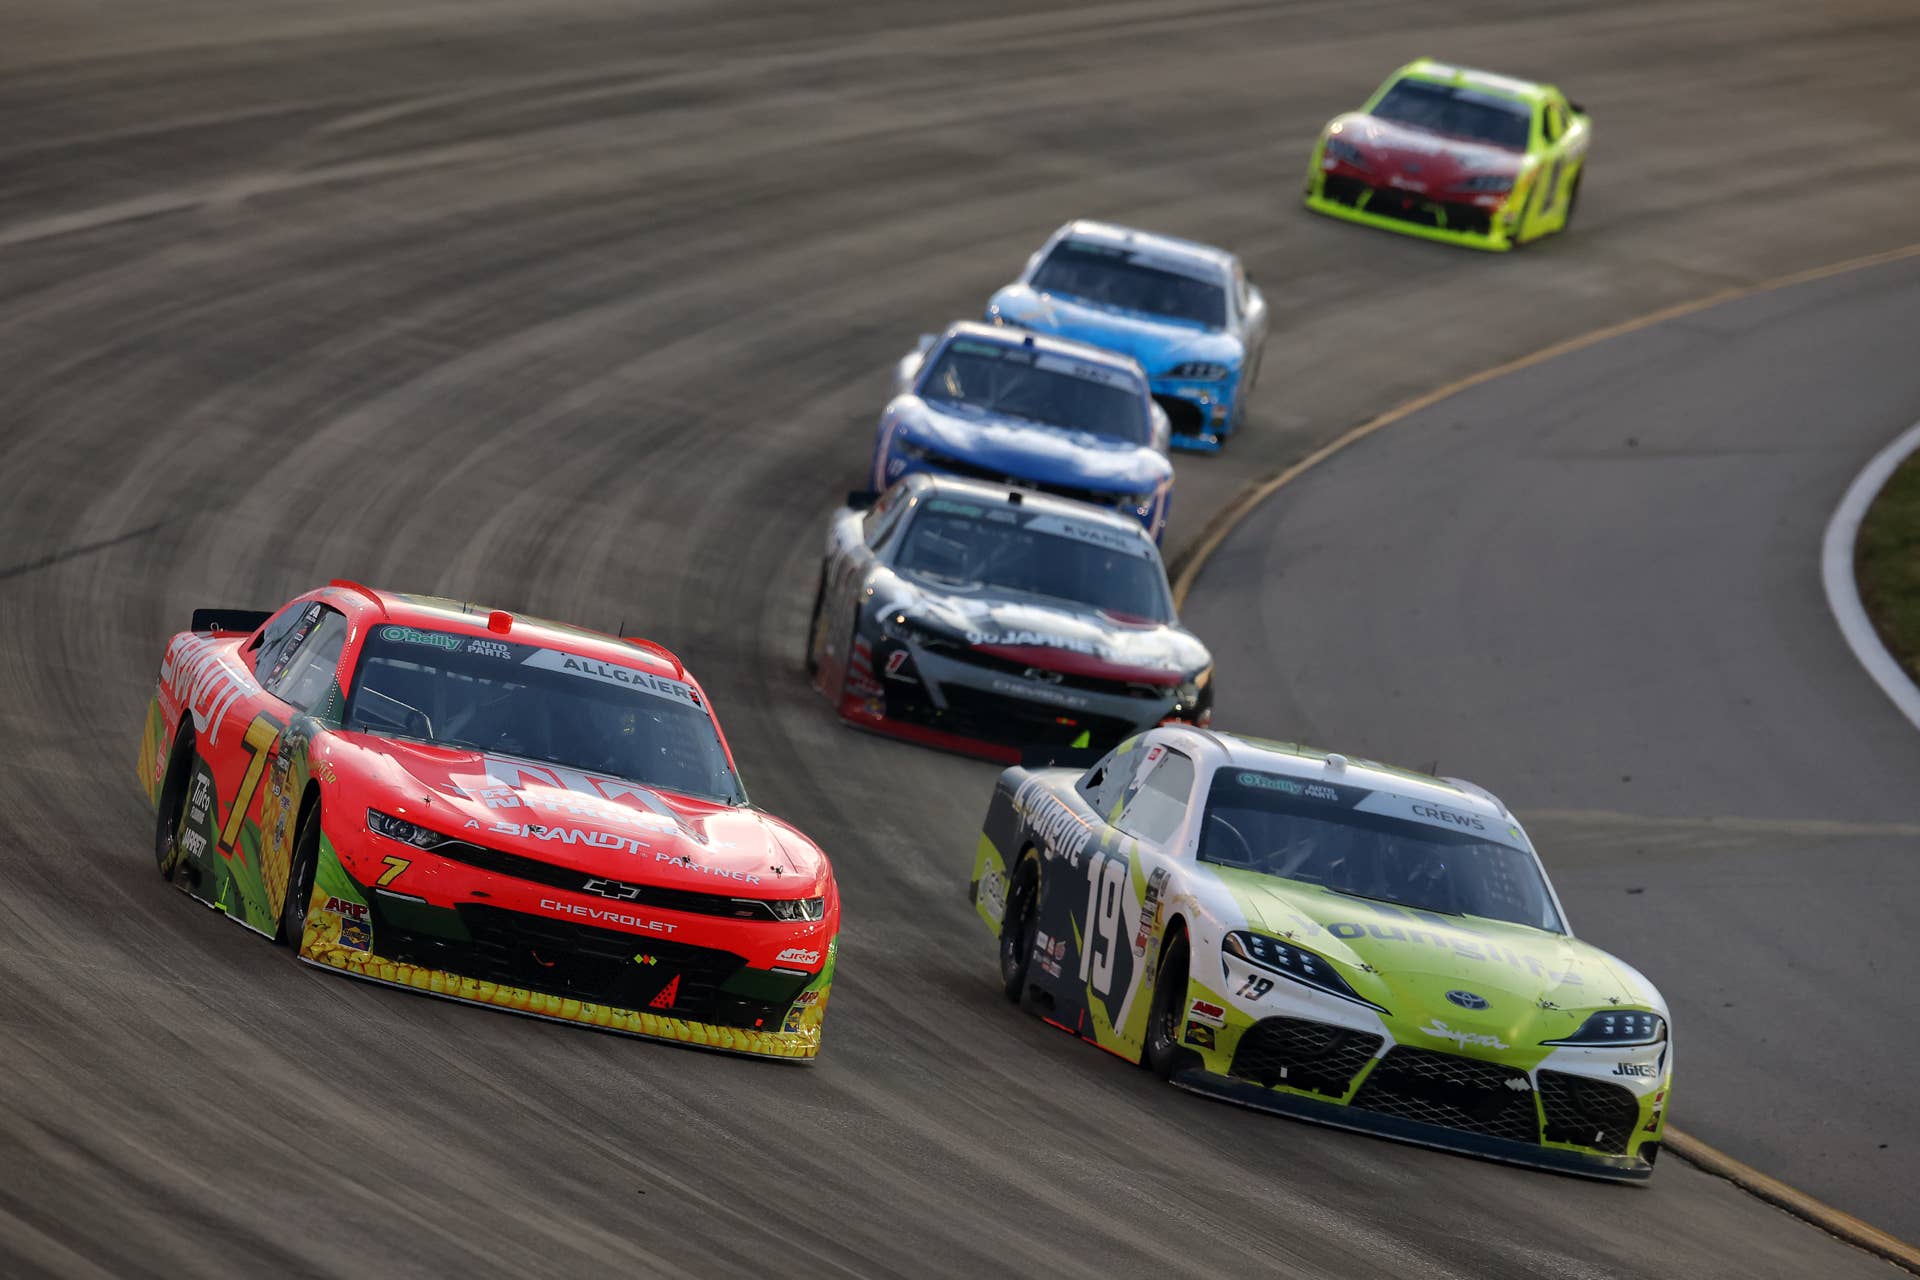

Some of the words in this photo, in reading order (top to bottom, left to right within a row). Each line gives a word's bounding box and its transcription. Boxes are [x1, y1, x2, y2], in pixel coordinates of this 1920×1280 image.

[467, 645, 512, 660] PARTS
[472, 639, 508, 652] AUTO
[563, 657, 690, 699] ALLGAIER
[217, 709, 285, 857] 7
[1411, 803, 1486, 831] CREWS
[463, 818, 481, 830] A
[488, 819, 650, 856] BRANDT
[655, 851, 761, 886] PARTNER
[374, 854, 412, 887] 7
[324, 896, 369, 918] ARP
[539, 897, 679, 934] CHEVROLET
[1078, 850, 1128, 997] 19
[780, 950, 817, 963] JRM
[1235, 973, 1275, 1002] 19
